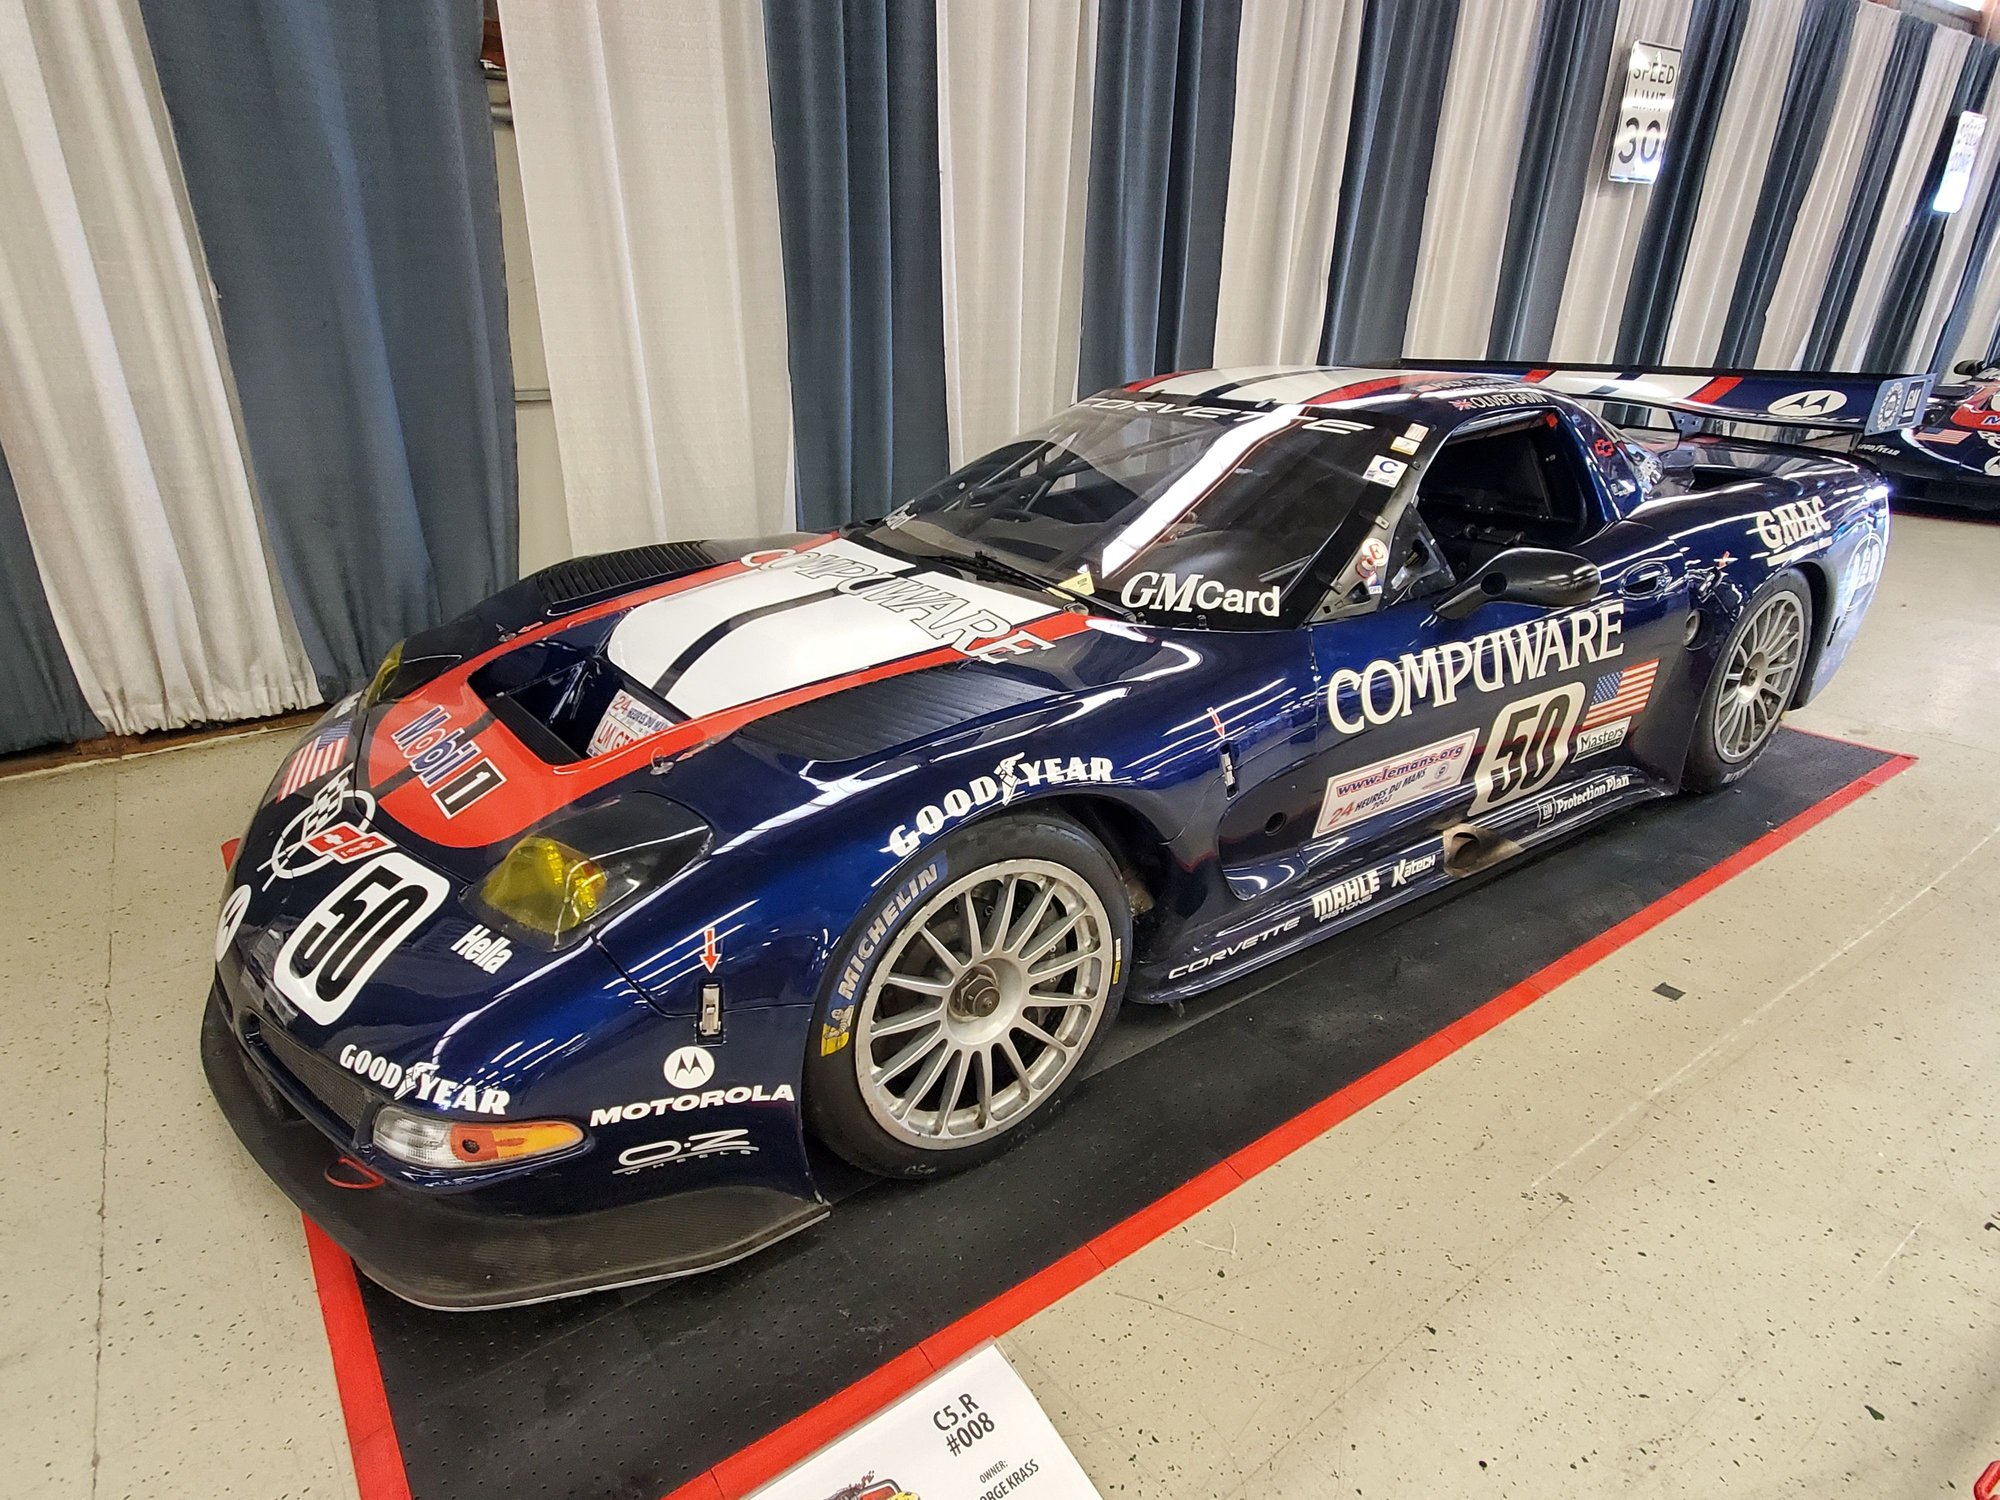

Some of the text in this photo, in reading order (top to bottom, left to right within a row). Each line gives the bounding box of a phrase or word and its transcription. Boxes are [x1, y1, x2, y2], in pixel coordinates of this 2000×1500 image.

[1618, 117, 1661, 164] 30
[1379, 460, 1399, 474] C
[1756, 495, 1832, 550] GMAC
[740, 549, 1057, 664] COMPUWARE
[1327, 602, 1625, 734] COMPUWARE
[612, 695, 632, 714] 24
[391, 704, 482, 789] Mobil
[1580, 727, 1625, 751] Masters
[1336, 742, 1466, 797] www.lemans.org
[1556, 784, 1606, 814] Protection
[1606, 774, 1630, 793] Plan
[889, 752, 1114, 858] GOODYEAR
[1328, 801, 1356, 828] 24
[1354, 788, 1387, 812] HEURES
[1387, 781, 1402, 796] DU
[1402, 767, 1428, 789] MANS
[1312, 870, 1380, 919] MAHLE
[289, 865, 430, 1003] 50
[450, 924, 513, 975] Hella
[837, 863, 938, 1001] MICHELIN
[1168, 915, 1301, 980] CORVETTE
[339, 1043, 511, 1116] GOODYEAR
[589, 1083, 795, 1127] MOTOROLA
[932, 1392, 981, 1432] C5.R
[945, 1411, 996, 1458] #008
[979, 1460, 1009, 1484] OWNER:
[1005, 1458, 1040, 1491] KRASS
